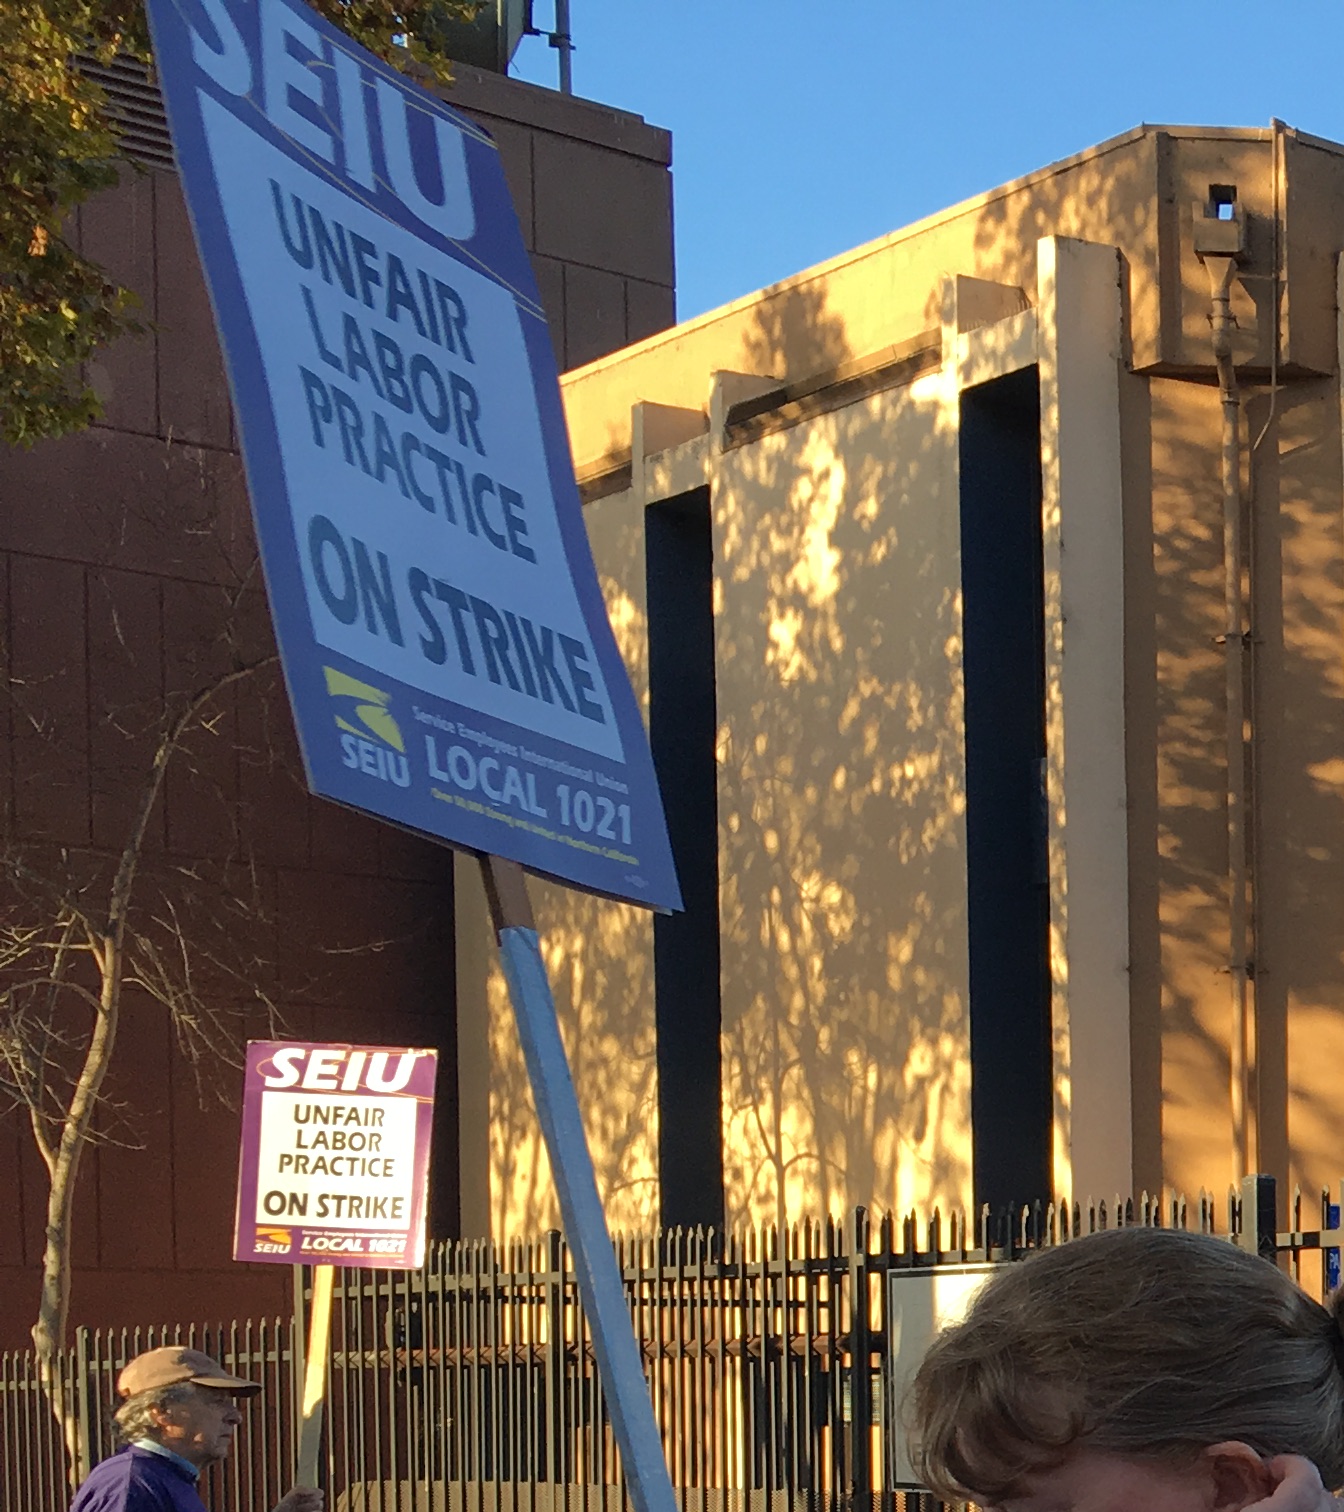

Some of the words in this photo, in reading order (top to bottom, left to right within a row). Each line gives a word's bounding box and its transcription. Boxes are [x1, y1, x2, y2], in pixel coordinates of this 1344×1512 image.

[187, 0, 476, 242] SEIU
[268, 178, 475, 364] UNFAIR
[299, 283, 486, 456] LABOR
[298, 364, 538, 564] PRACTICE
[308, 514, 405, 648] ON
[407, 566, 605, 724] STRIKE
[340, 733, 412, 788] SEIU
[425, 734, 548, 819] LOCAL
[556, 784, 632, 845] 1021
[264, 1047, 418, 1092] SEIU
[294, 1104, 385, 1127] UNFAIR
[295, 1129, 382, 1152] LABOR
[278, 1153, 395, 1177] PRACTICE
[263, 1190, 308, 1216] ON
[316, 1193, 404, 1219] STRIKE
[254, 1243, 291, 1254] SEIU
[301, 1237, 364, 1252] LOCAL
[368, 1239, 407, 1253] 1021
